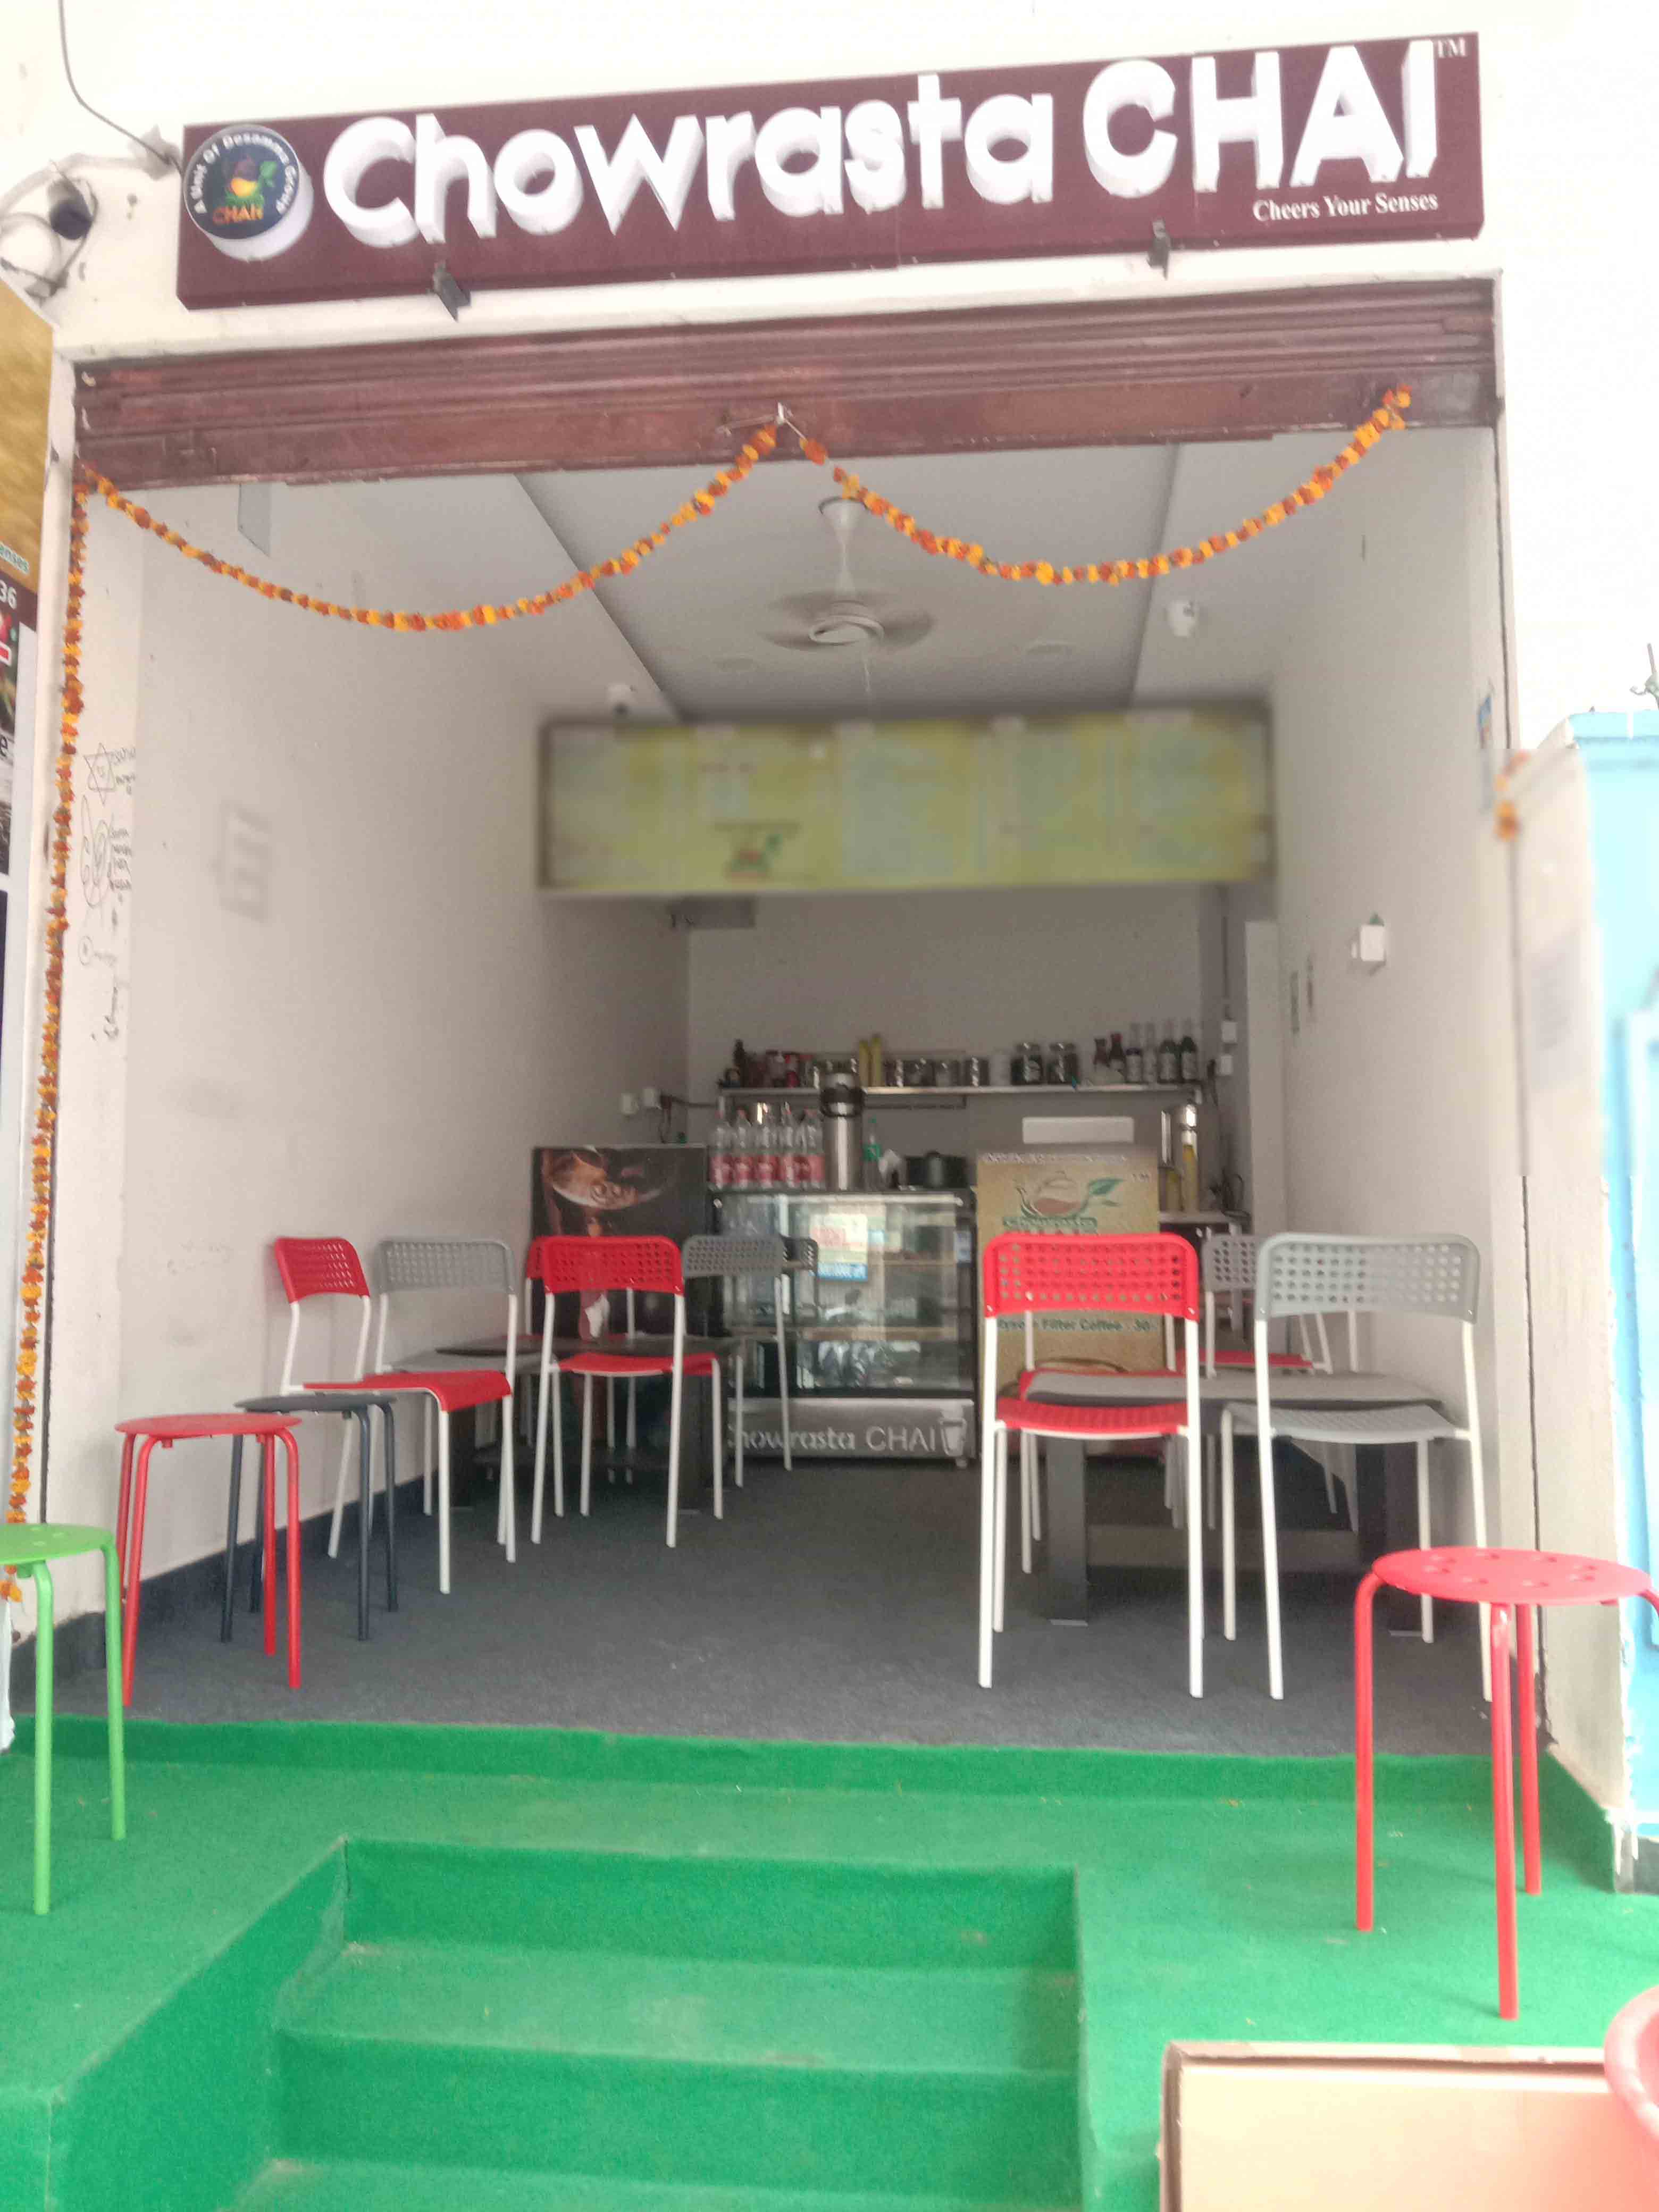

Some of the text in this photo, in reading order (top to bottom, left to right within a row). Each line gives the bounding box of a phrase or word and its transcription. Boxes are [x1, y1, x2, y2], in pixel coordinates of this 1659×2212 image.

[1434, 37, 1465, 58] TM
[323, 39, 1437, 248] Chowrasta CHAI
[1252, 192, 1439, 222] Cheers Your Senses
[866, 1426, 936, 1451] CHAI
